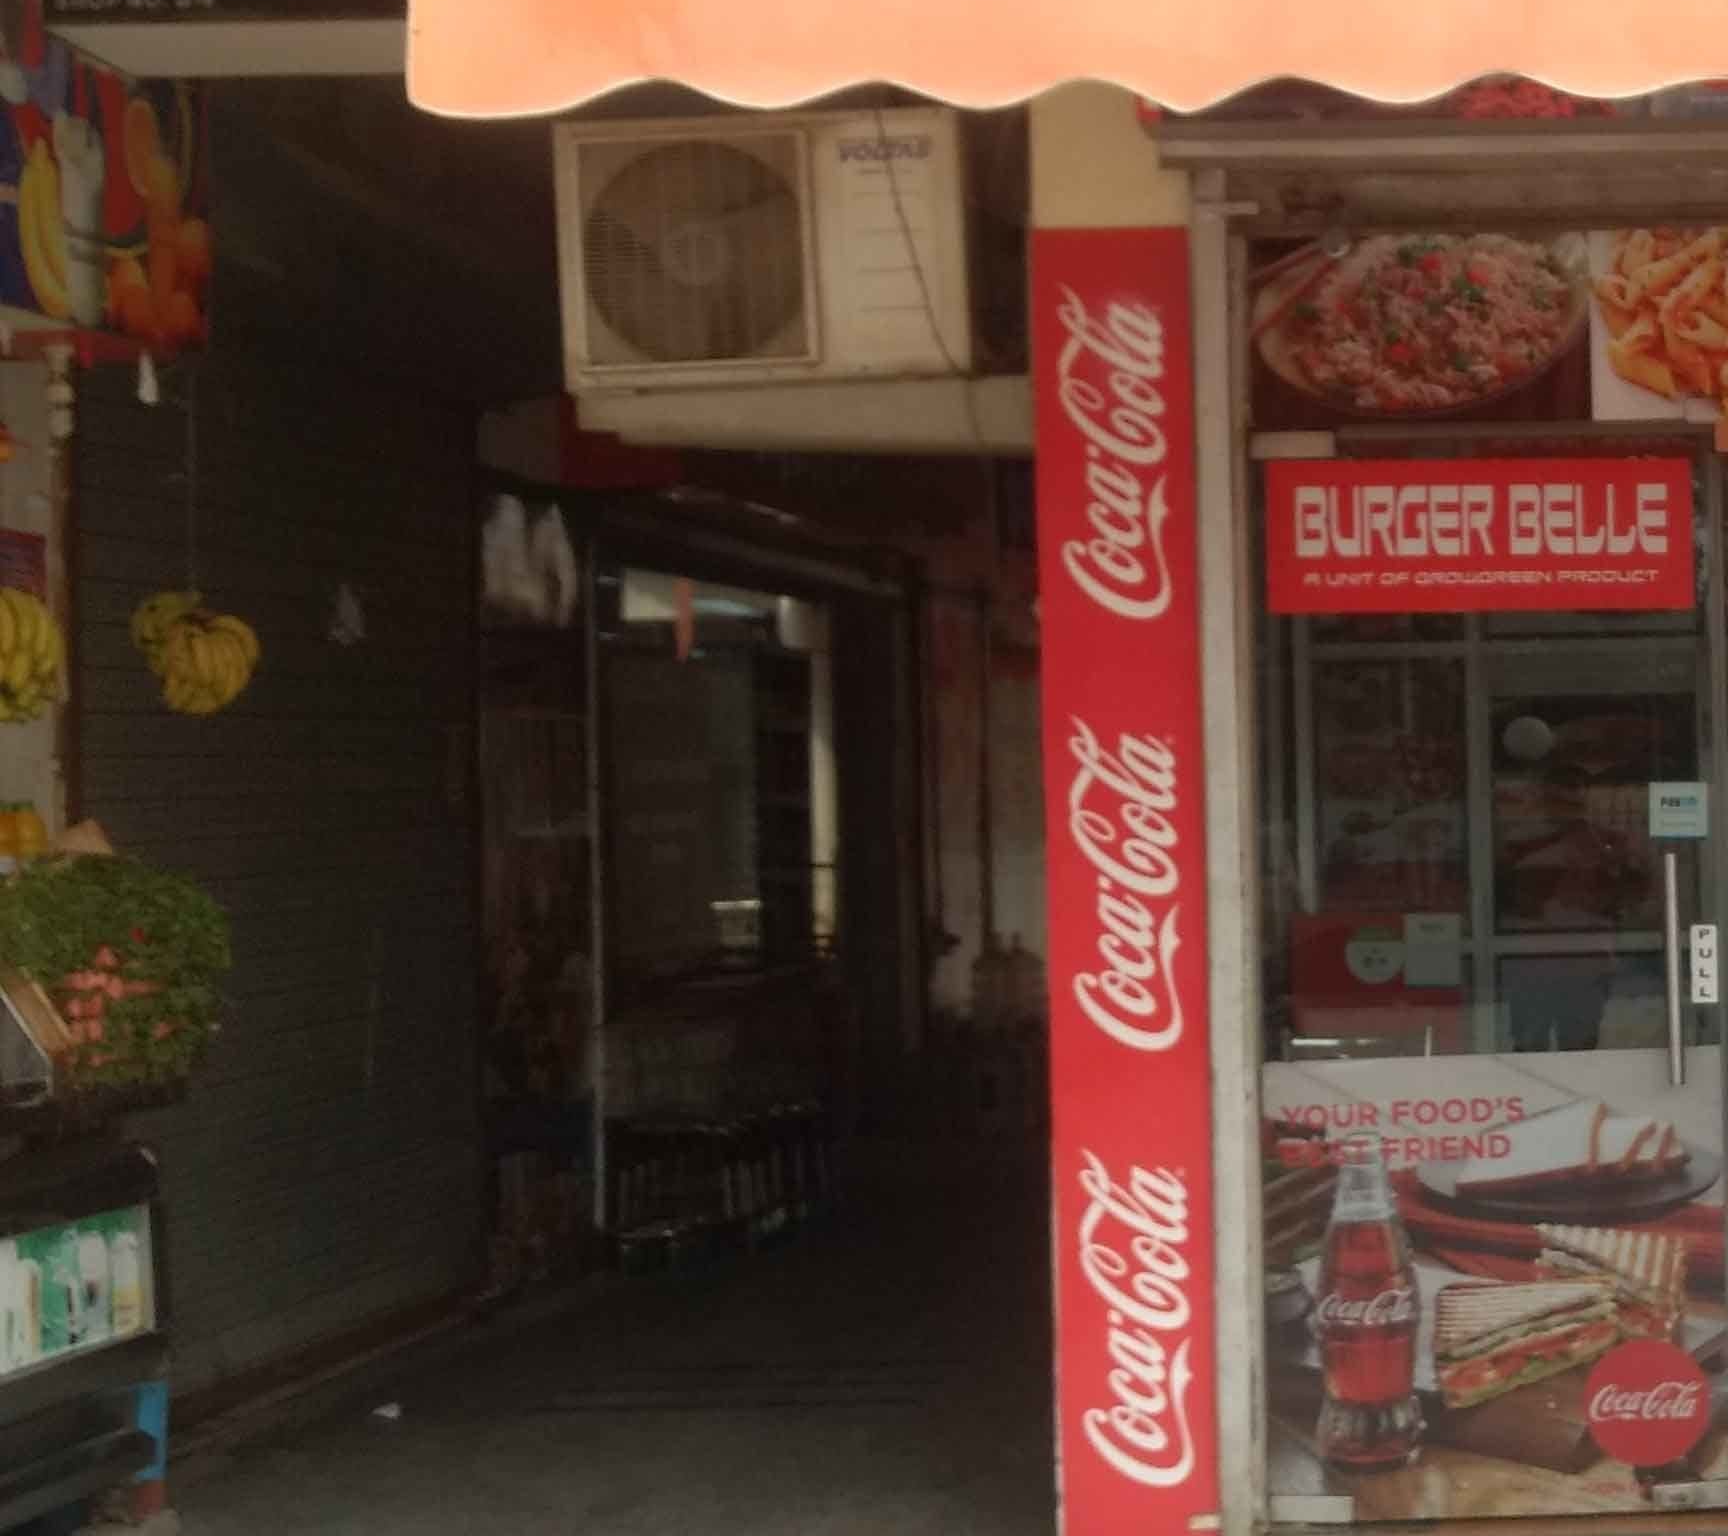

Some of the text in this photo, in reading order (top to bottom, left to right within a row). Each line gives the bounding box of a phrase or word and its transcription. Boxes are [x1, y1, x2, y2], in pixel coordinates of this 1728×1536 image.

[1059, 283, 1171, 621] Coca-Cola
[1294, 482, 1669, 558] BURGER BELLE
[1326, 571, 1376, 586] UNIT
[1380, 570, 1411, 585] OF
[1557, 568, 1660, 584] PRODUCT
[1069, 714, 1184, 1053] Coca-Cola
[1281, 1096, 1526, 1129] YOUR FOOD'S
[1381, 1133, 1513, 1162] FRIEND
[1079, 1147, 1195, 1490] Coca-Cola
[1589, 1380, 1703, 1421] Coca-Cola
